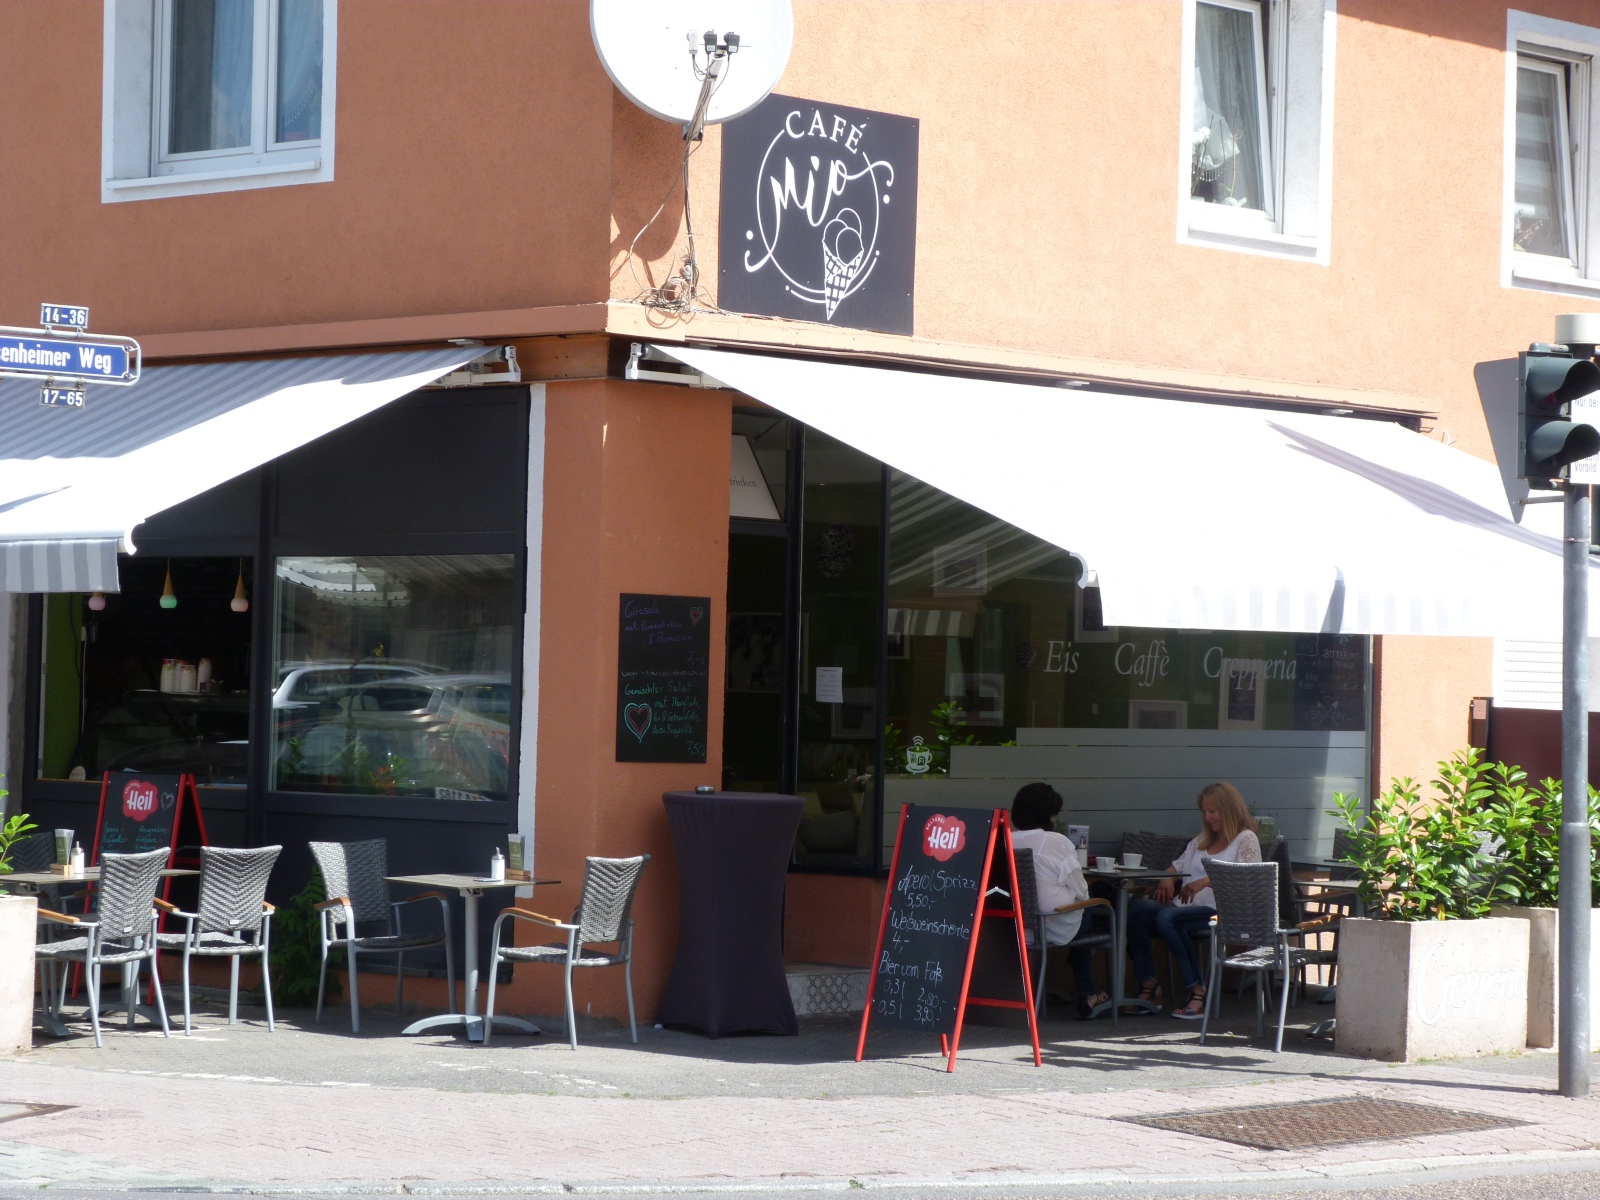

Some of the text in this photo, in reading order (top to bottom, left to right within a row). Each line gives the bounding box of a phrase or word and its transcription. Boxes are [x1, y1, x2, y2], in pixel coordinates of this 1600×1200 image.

[785, 109, 867, 154] CAFÉ
[44, 306, 86, 325] 14-36
[0, 342, 112, 374] enheimer Weg
[43, 388, 84, 406] 17-65
[1575, 463, 1596, 473] Vorbild
[1043, 640, 1080, 674] Eis
[1114, 639, 1170, 687] Caffè
[1203, 646, 1297, 691] Crepperia
[127, 791, 153, 810] Heil
[925, 816, 946, 831] KELTEREI
[927, 826, 960, 849] Heil
[897, 865, 934, 895] Aperol
[878, 950, 898, 975] Bier
[901, 963, 919, 978] vom
